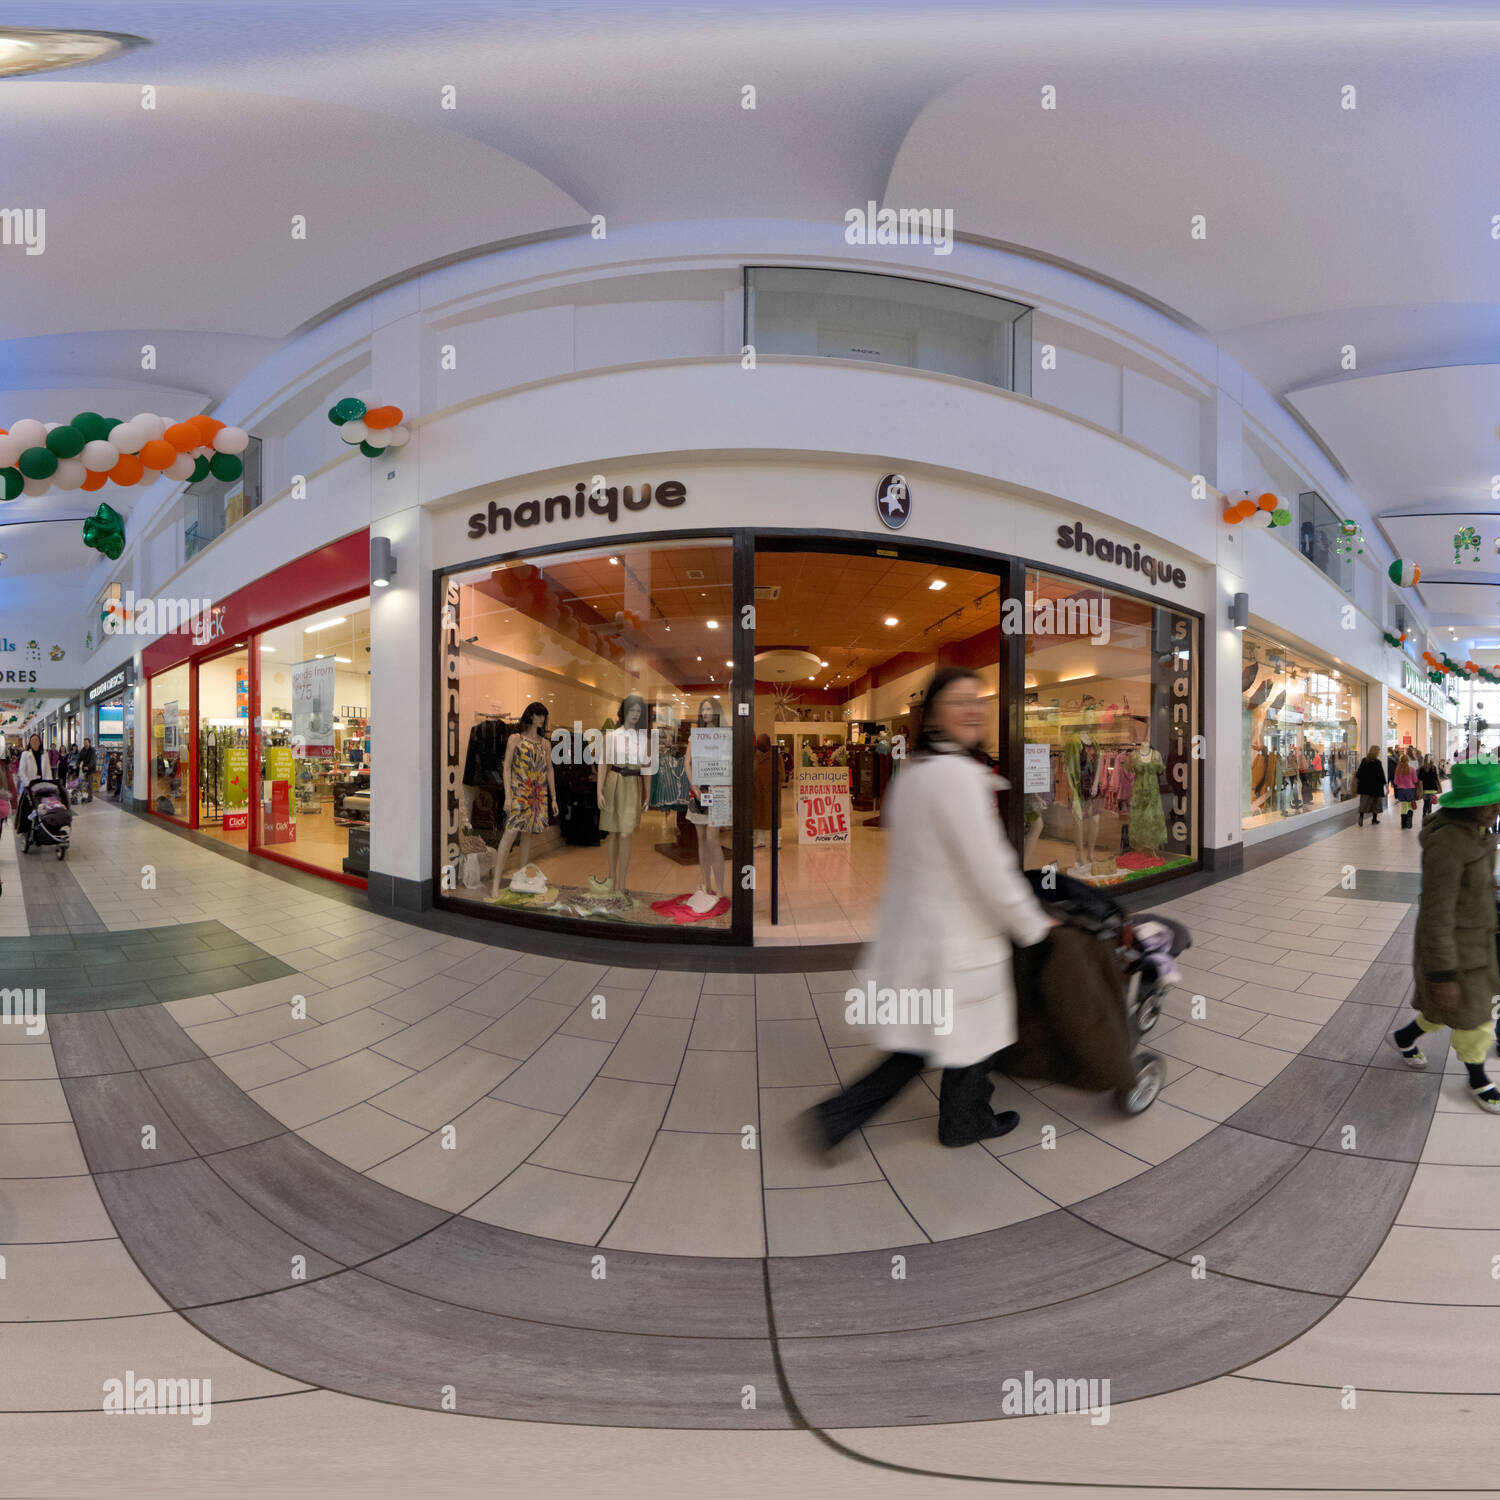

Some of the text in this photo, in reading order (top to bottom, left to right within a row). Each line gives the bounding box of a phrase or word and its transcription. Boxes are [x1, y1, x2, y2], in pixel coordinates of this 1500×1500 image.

[467, 480, 687, 539] shanique
[1056, 521, 1187, 589] shanique
[1172, 620, 1189, 841] shanique
[799, 771, 848, 782] shanique
[799, 785, 848, 795] BARGAIN RAIL
[803, 795, 842, 817] 70%
[805, 814, 848, 837] SALE
